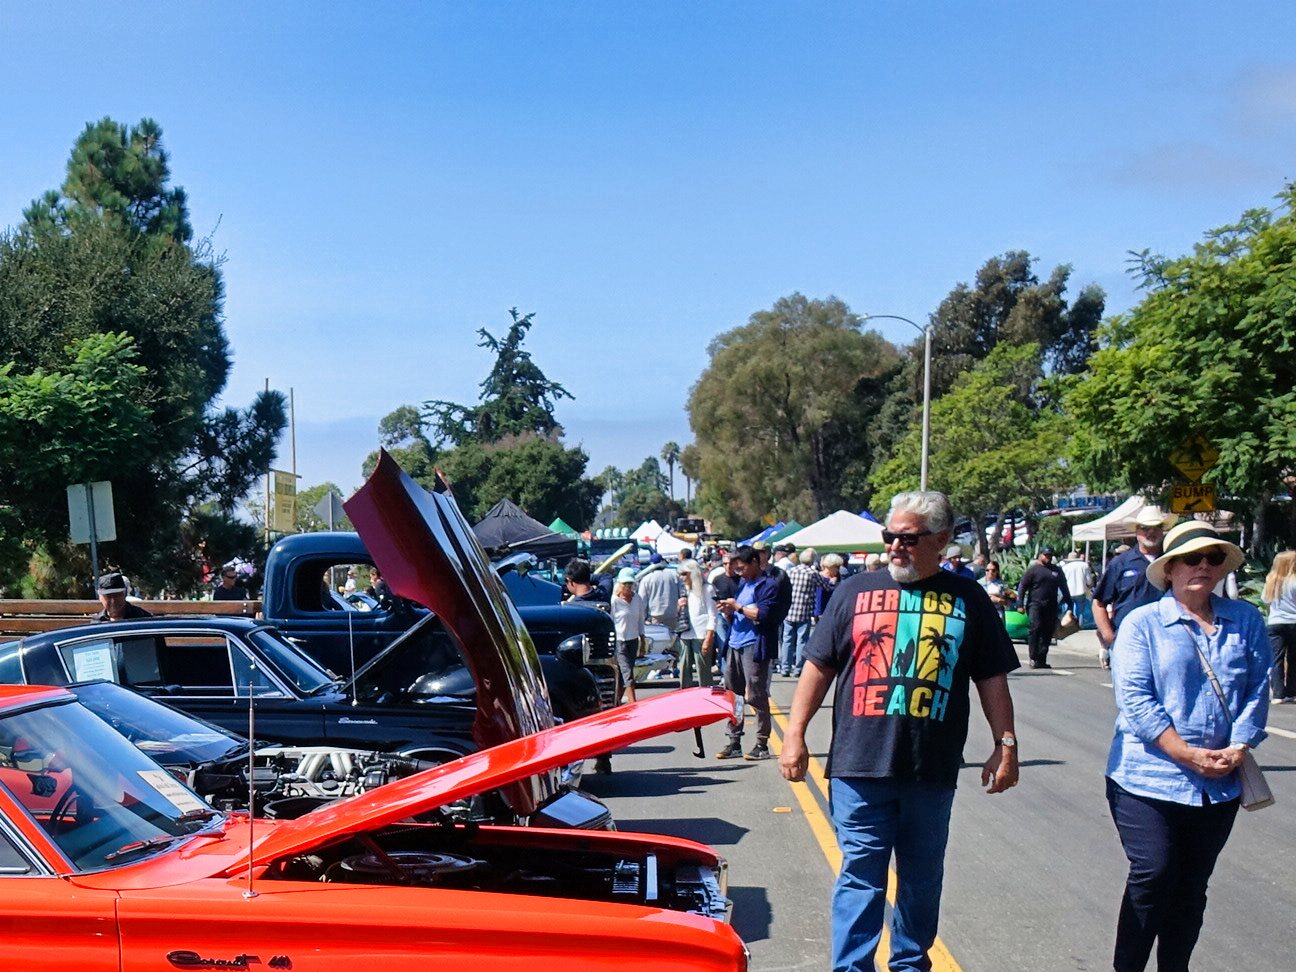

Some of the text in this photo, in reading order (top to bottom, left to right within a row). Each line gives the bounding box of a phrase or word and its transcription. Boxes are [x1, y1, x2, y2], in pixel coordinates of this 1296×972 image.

[1174, 486, 1213, 499] BUMP
[854, 588, 966, 619] HERMOSA
[852, 684, 949, 722] BEACH
